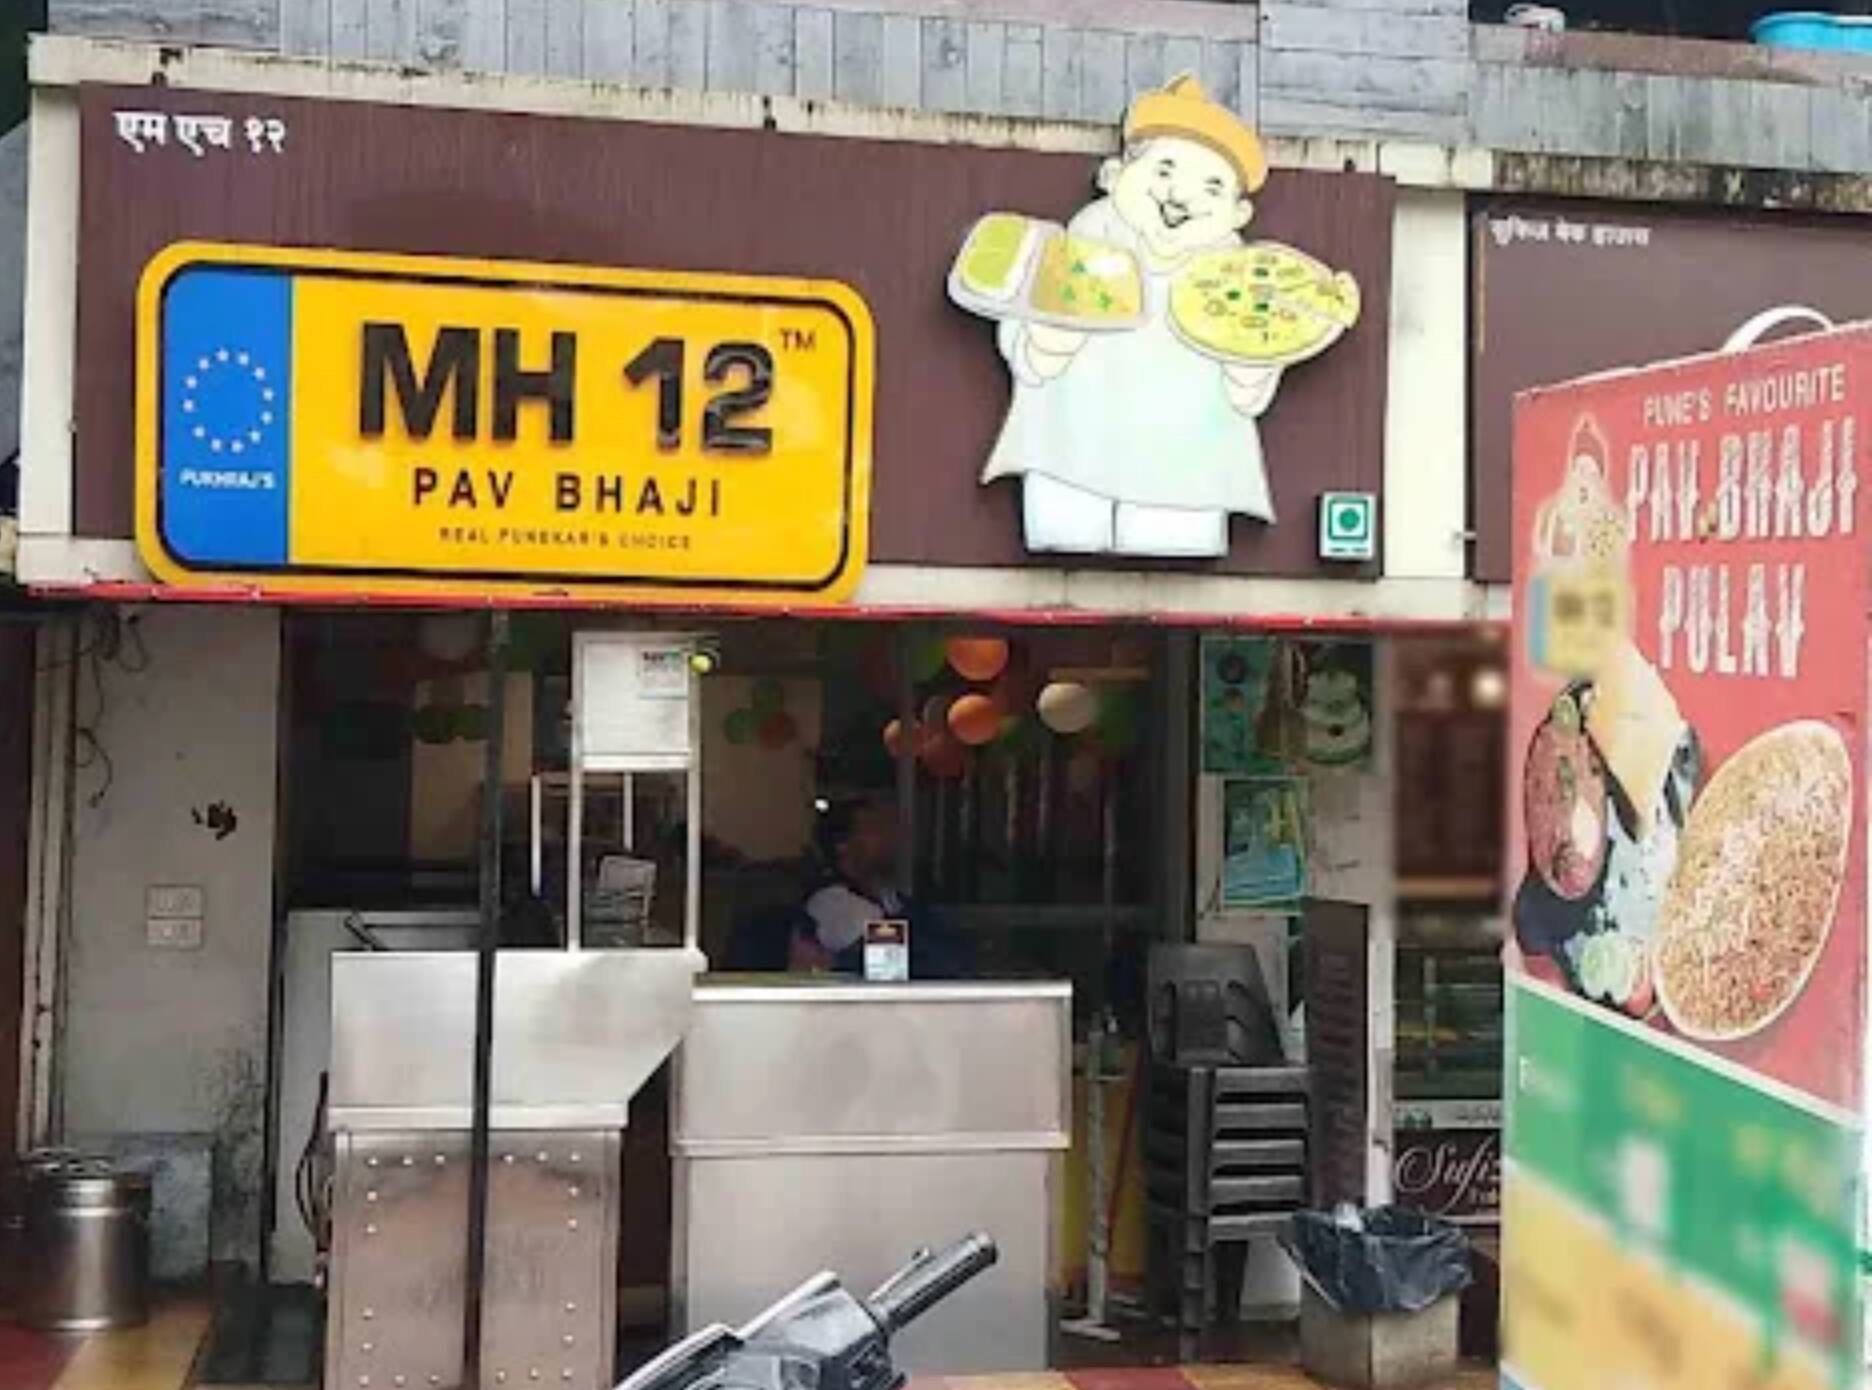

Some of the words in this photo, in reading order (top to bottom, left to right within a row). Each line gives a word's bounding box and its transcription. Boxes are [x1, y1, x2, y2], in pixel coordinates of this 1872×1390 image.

[112, 111, 168, 153] एम
[172, 115, 233, 157] एच
[244, 116, 286, 154] १२
[359, 322, 578, 446] MH
[623, 336, 775, 457] 12
[780, 327, 817, 351] TM
[1643, 387, 1713, 427] PUNE'S
[1723, 363, 1847, 416] FAVOURITE
[413, 466, 515, 510] PAV
[556, 473, 721, 517] BHAJI
[1626, 440, 1701, 542] PAV
[1715, 415, 1859, 541] BHAJI
[439, 526, 488, 545] REAL
[499, 527, 609, 547] PUNEKAR'S
[618, 531, 691, 549] CHOICE
[1658, 562, 1806, 679] PULAV
